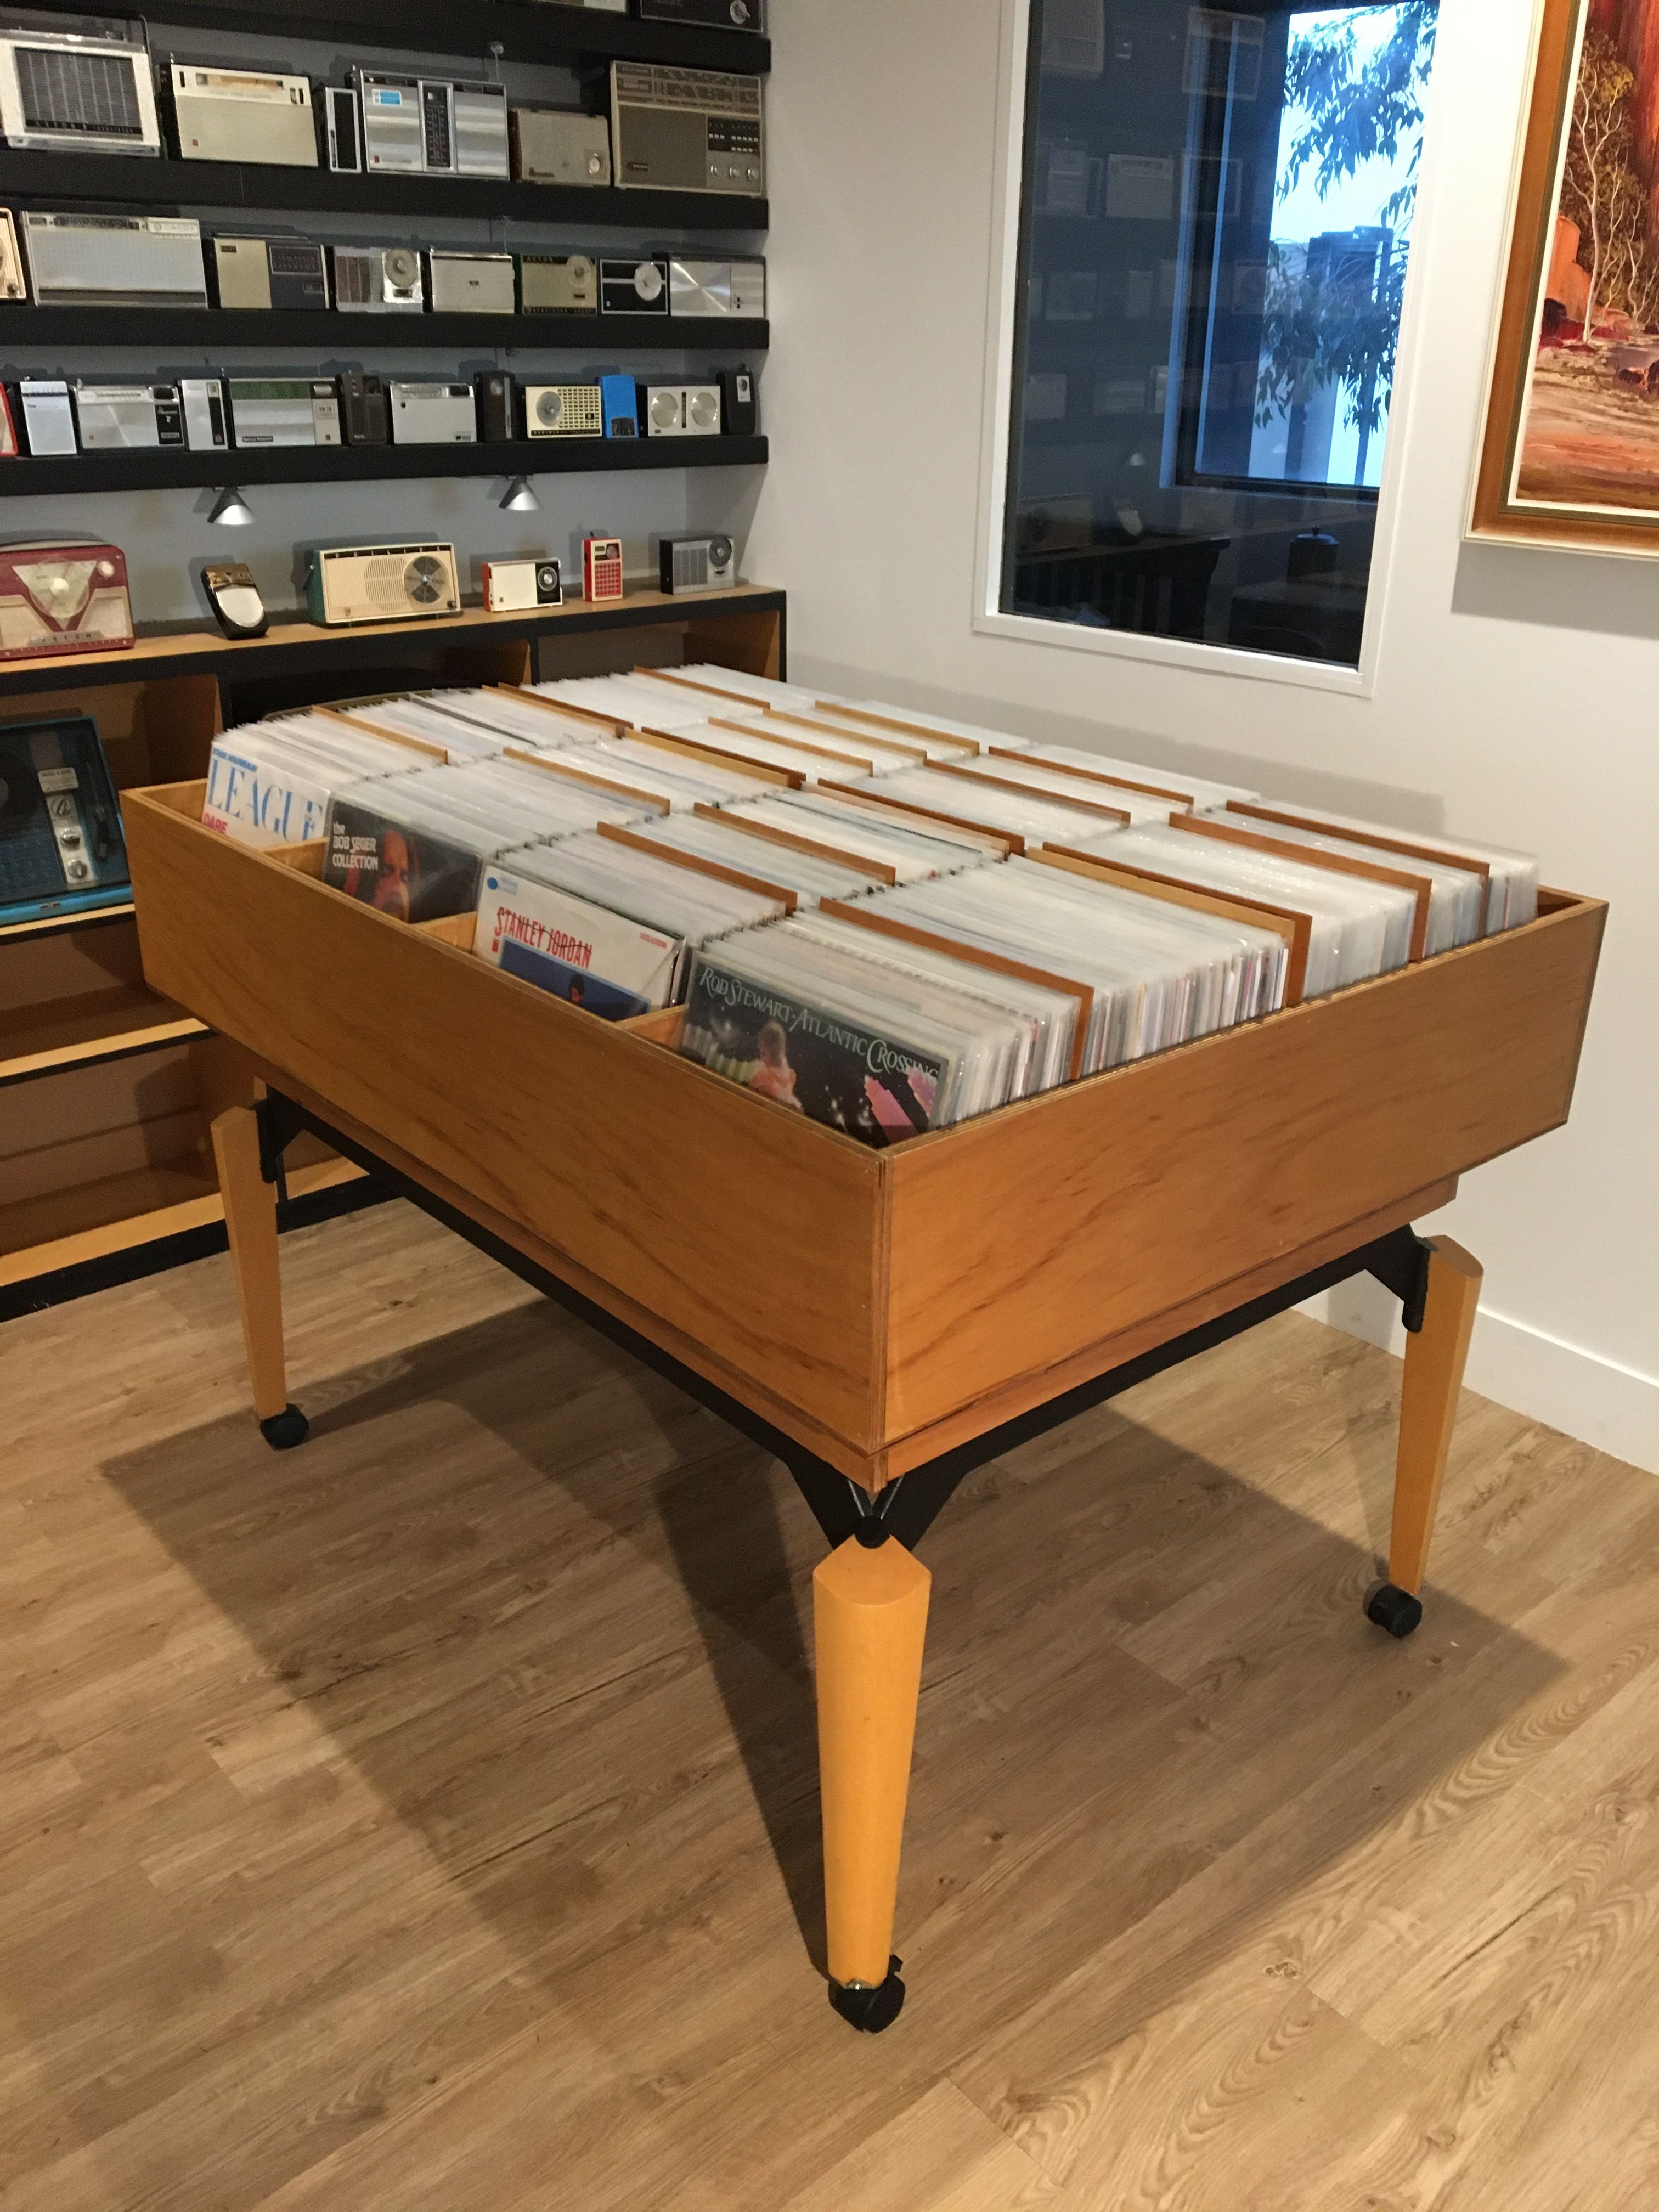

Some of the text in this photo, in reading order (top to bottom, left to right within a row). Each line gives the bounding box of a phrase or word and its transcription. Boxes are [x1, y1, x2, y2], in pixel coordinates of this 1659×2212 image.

[207, 759, 323, 843] LEAGUE
[332, 836, 377, 854] BOB SEGER
[333, 822, 345, 835] the
[332, 853, 378, 871] COLLECTION
[495, 906, 592, 969] STANLEY JORDAN
[699, 966, 729, 999] ROD
[788, 1008, 867, 1056] ATLANTIC
[866, 1039, 939, 1079] CROSSING
